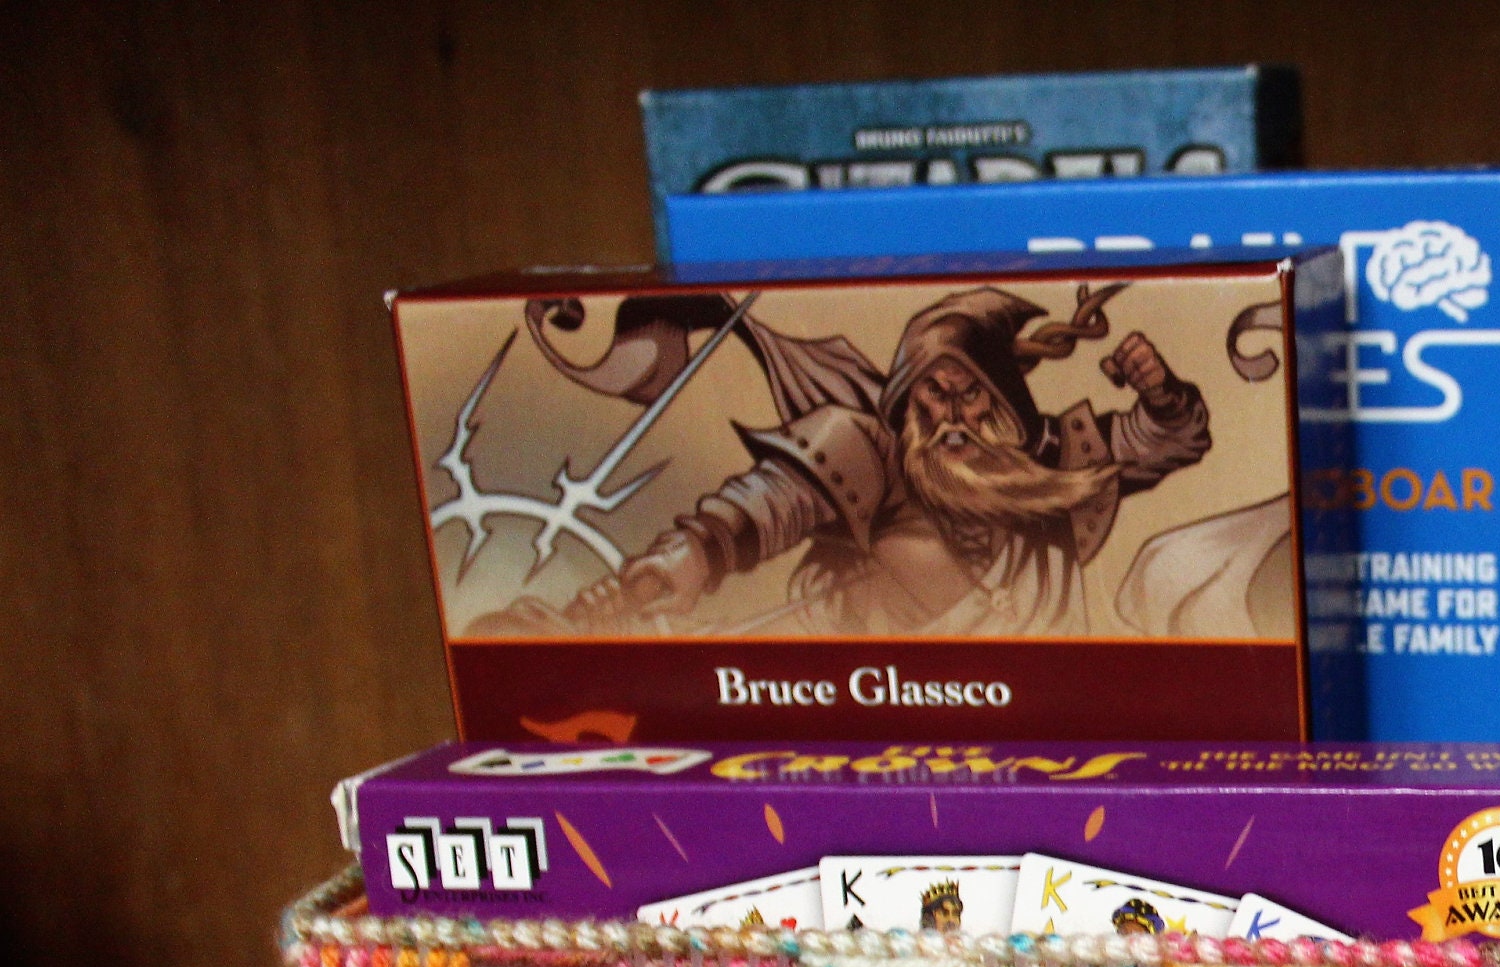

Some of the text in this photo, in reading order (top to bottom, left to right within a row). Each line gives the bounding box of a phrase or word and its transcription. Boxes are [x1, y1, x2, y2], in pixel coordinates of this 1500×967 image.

[1357, 588, 1498, 621] AME FOR
[1392, 623, 1500, 655] FAMILY
[715, 664, 1012, 707] Bruce Glassco
[841, 868, 866, 907] K
[1040, 869, 1073, 912] K
[1458, 884, 1497, 901] BEST
